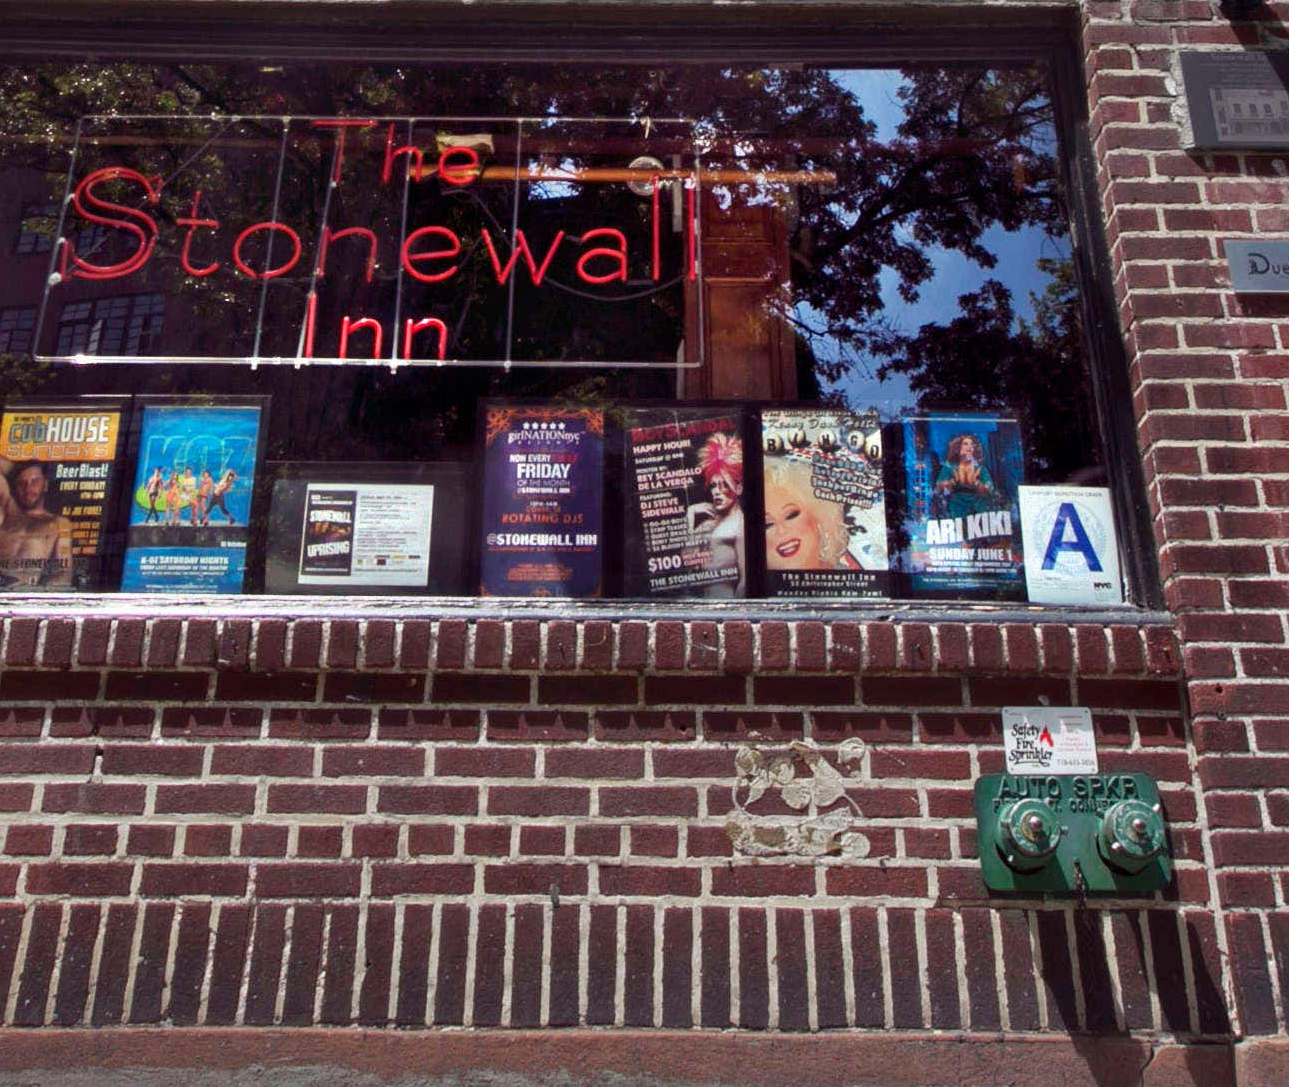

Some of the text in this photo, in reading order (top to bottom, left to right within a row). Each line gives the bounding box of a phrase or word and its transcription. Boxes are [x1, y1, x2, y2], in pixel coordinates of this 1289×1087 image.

[312, 119, 479, 186] The
[58, 166, 698, 286] Stonewall
[305, 291, 448, 361] Inn
[633, 442, 662, 455] HAPPY
[517, 463, 571, 479] FRIDAY
[656, 467, 703, 480] SCANDALO
[638, 482, 650, 491] DE
[651, 480, 663, 489] LA
[654, 497, 679, 508] STEVE
[642, 505, 686, 519] SIDEWALK
[926, 510, 1013, 545] ARI KIKI
[487, 533, 598, 546] @STONEWALL INN
[1041, 502, 1104, 573] A
[307, 540, 351, 558] UPRISING
[929, 547, 976, 561] SUNDAY
[977, 548, 1004, 561] JUNE
[648, 554, 682, 573] $100
[650, 577, 666, 588] THE
[668, 571, 719, 585] STONEWALL
[782, 573, 876, 581] The Stonewall Inn
[1093, 582, 1112, 590] NYC
[1011, 723, 1040, 740] Safety
[1016, 737, 1035, 750] Fire
[1008, 747, 1054, 766] Sprinkler
[999, 775, 1140, 799] AUTO SPKR
